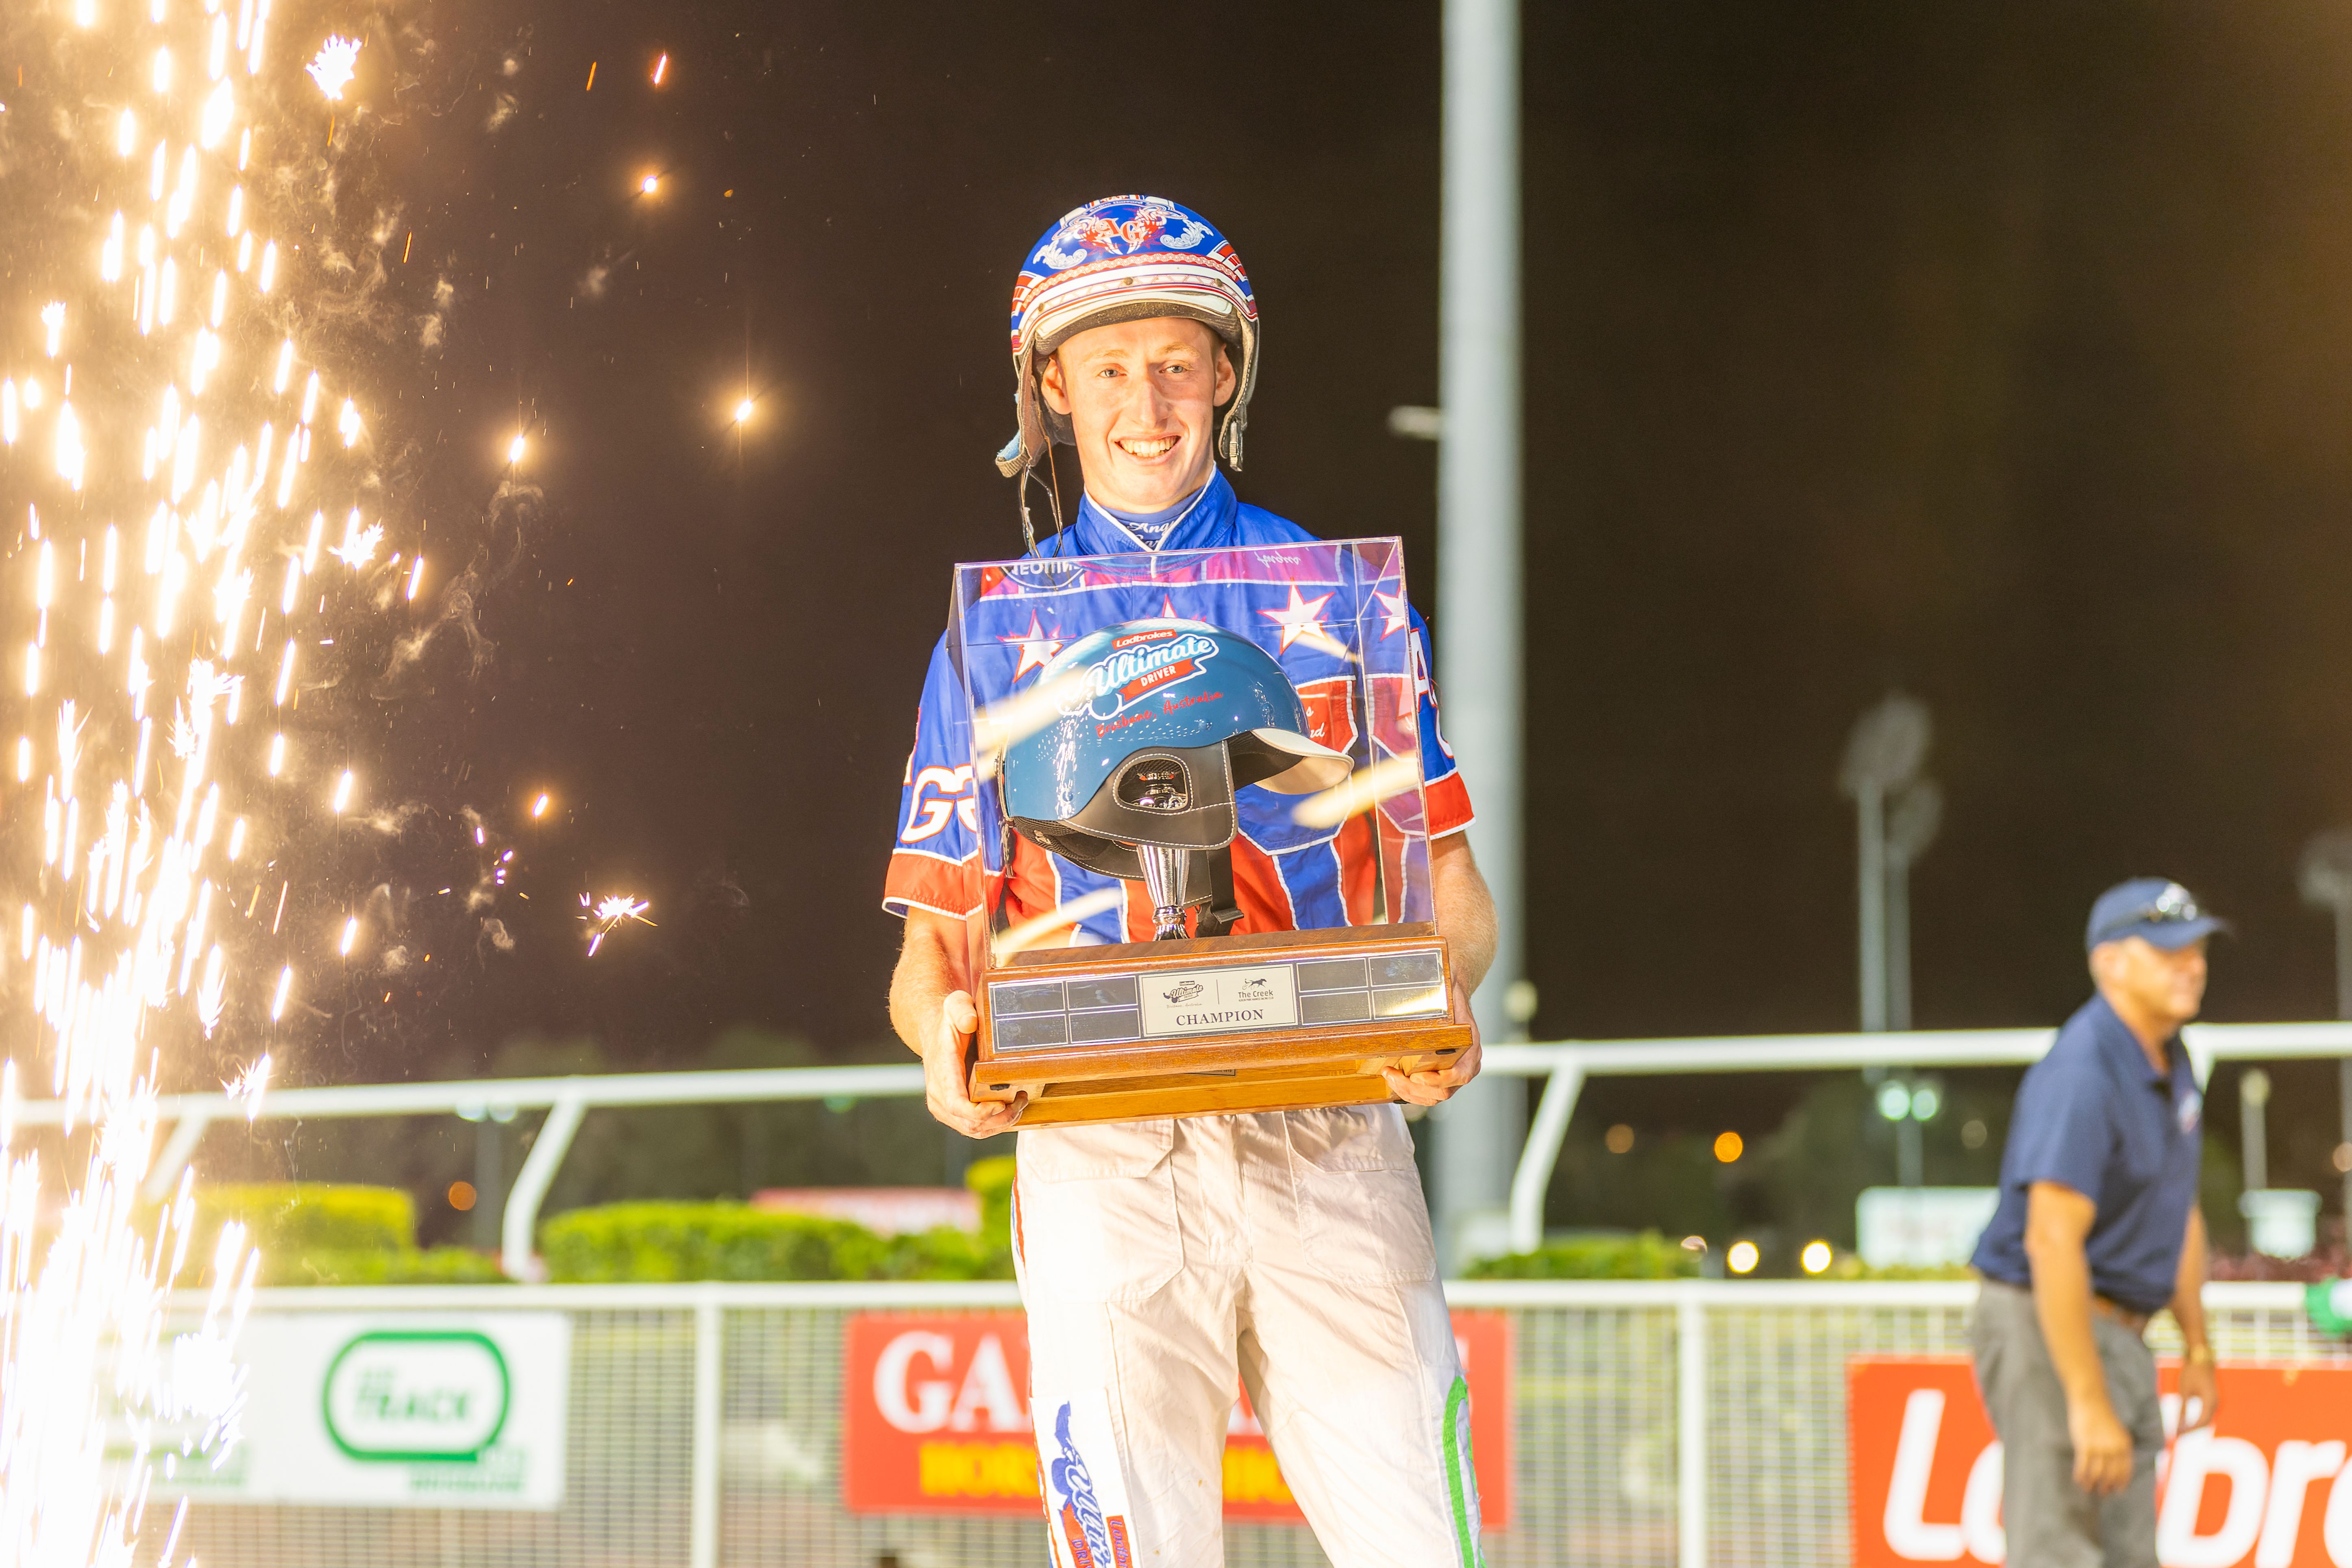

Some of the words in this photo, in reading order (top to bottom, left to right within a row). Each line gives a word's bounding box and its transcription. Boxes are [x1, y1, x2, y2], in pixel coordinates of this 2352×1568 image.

[1116, 631, 1173, 648] Ladbrokes
[1094, 636, 1213, 696] Ultimate
[1140, 665, 1177, 687] DRIVER
[1163, 690, 1224, 715] Australia
[1171, 984, 1203, 998] Ultimate
[1253, 989, 1273, 997] Creek
[1176, 1009, 1264, 1026] CHAMPION
